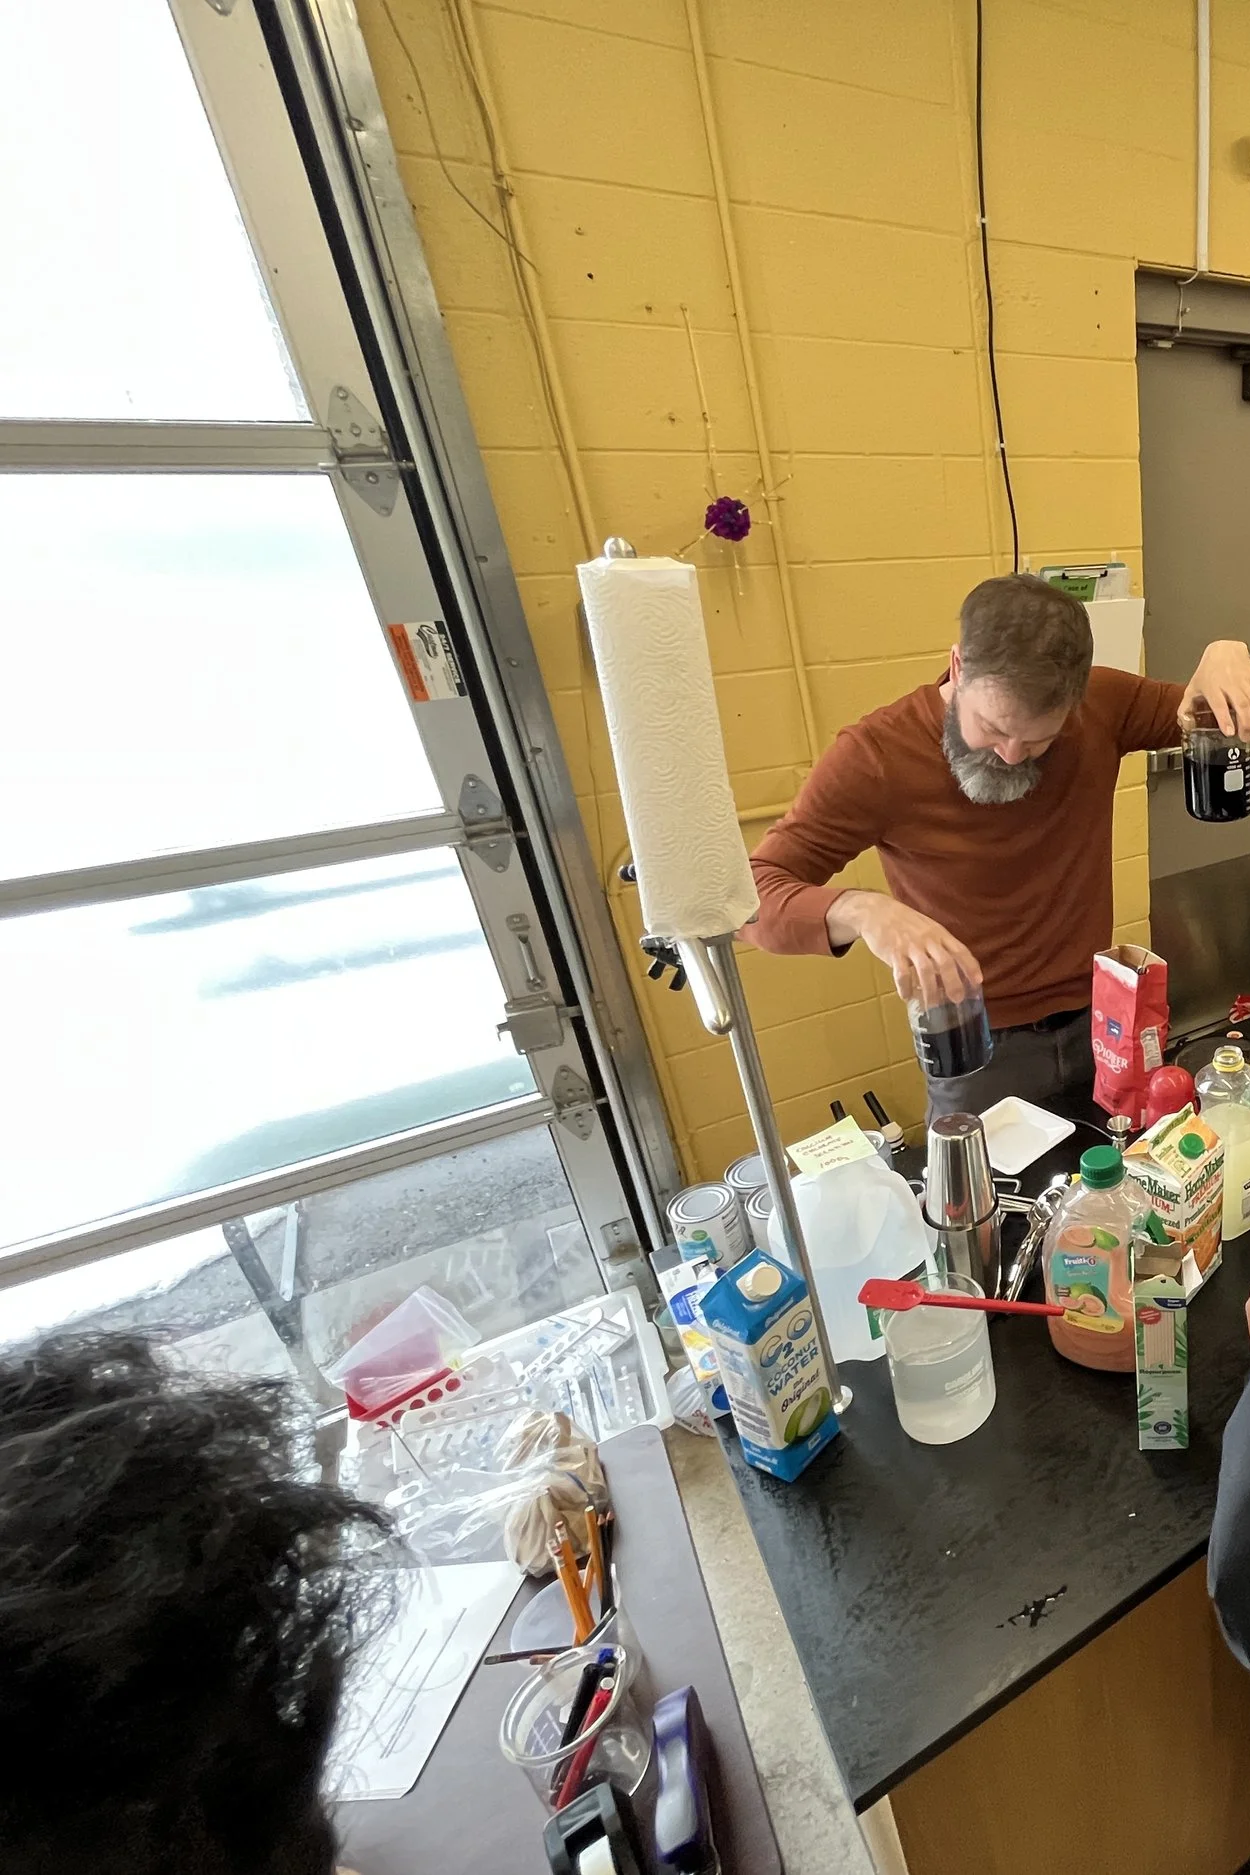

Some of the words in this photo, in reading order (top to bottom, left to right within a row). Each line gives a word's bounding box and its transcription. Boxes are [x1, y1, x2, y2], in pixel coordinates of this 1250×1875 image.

[1092, 1039, 1128, 1069] PIONEER
[767, 1337, 817, 1388] COCONUT
[769, 1346, 819, 1397] WATER
[781, 1367, 820, 1412] Original
